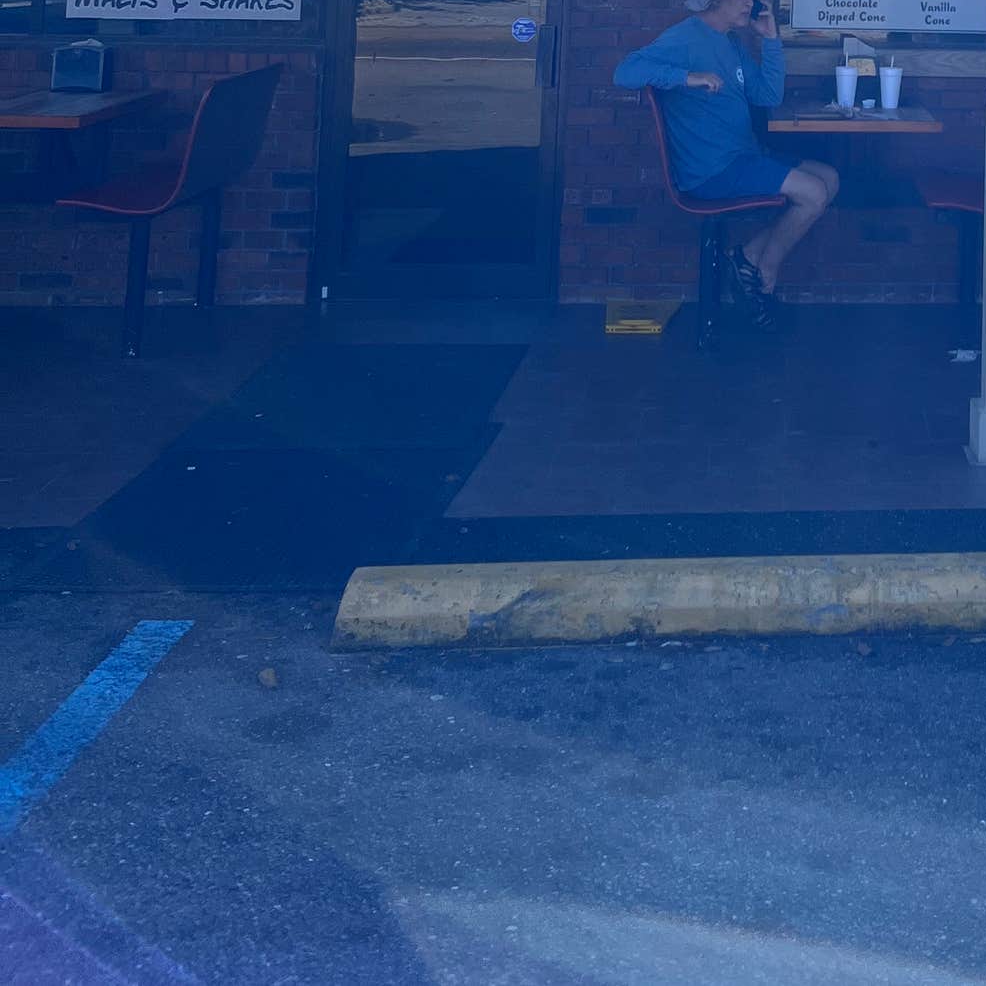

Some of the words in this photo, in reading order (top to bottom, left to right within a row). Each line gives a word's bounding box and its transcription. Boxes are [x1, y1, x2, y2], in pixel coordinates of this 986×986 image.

[920, 1, 957, 13] Vanilla
[817, 11, 855, 25] Dipped
[859, 12, 886, 22] Cone
[924, 14, 951, 25] Cone
